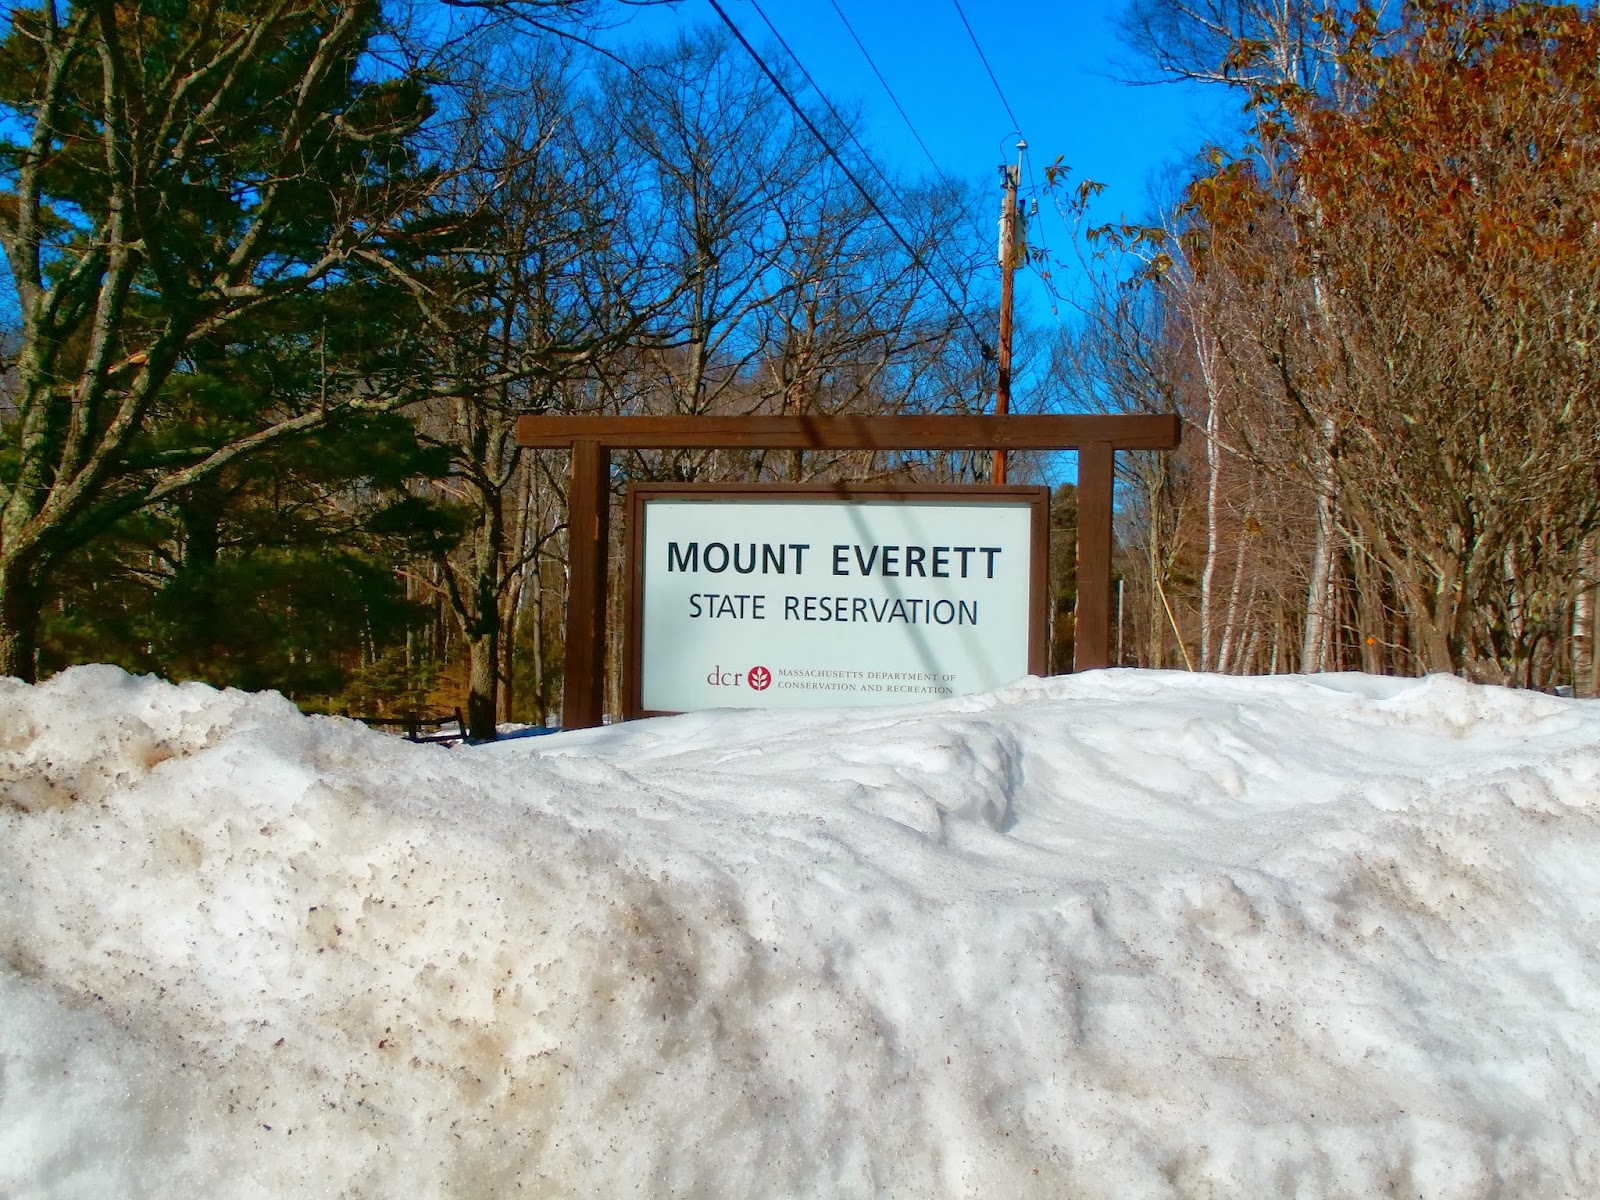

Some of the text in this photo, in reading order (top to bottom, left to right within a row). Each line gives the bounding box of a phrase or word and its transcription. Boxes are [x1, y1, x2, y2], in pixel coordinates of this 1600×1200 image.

[667, 541, 1003, 579] MOUNT EVERETT
[689, 593, 978, 626] STATE RESERVATION
[707, 665, 742, 686] dcr
[778, 668, 956, 682] MASSACHUSETTS DEPARTMENT OF
[777, 681, 954, 694] CONSERVATION AND RECREATION
